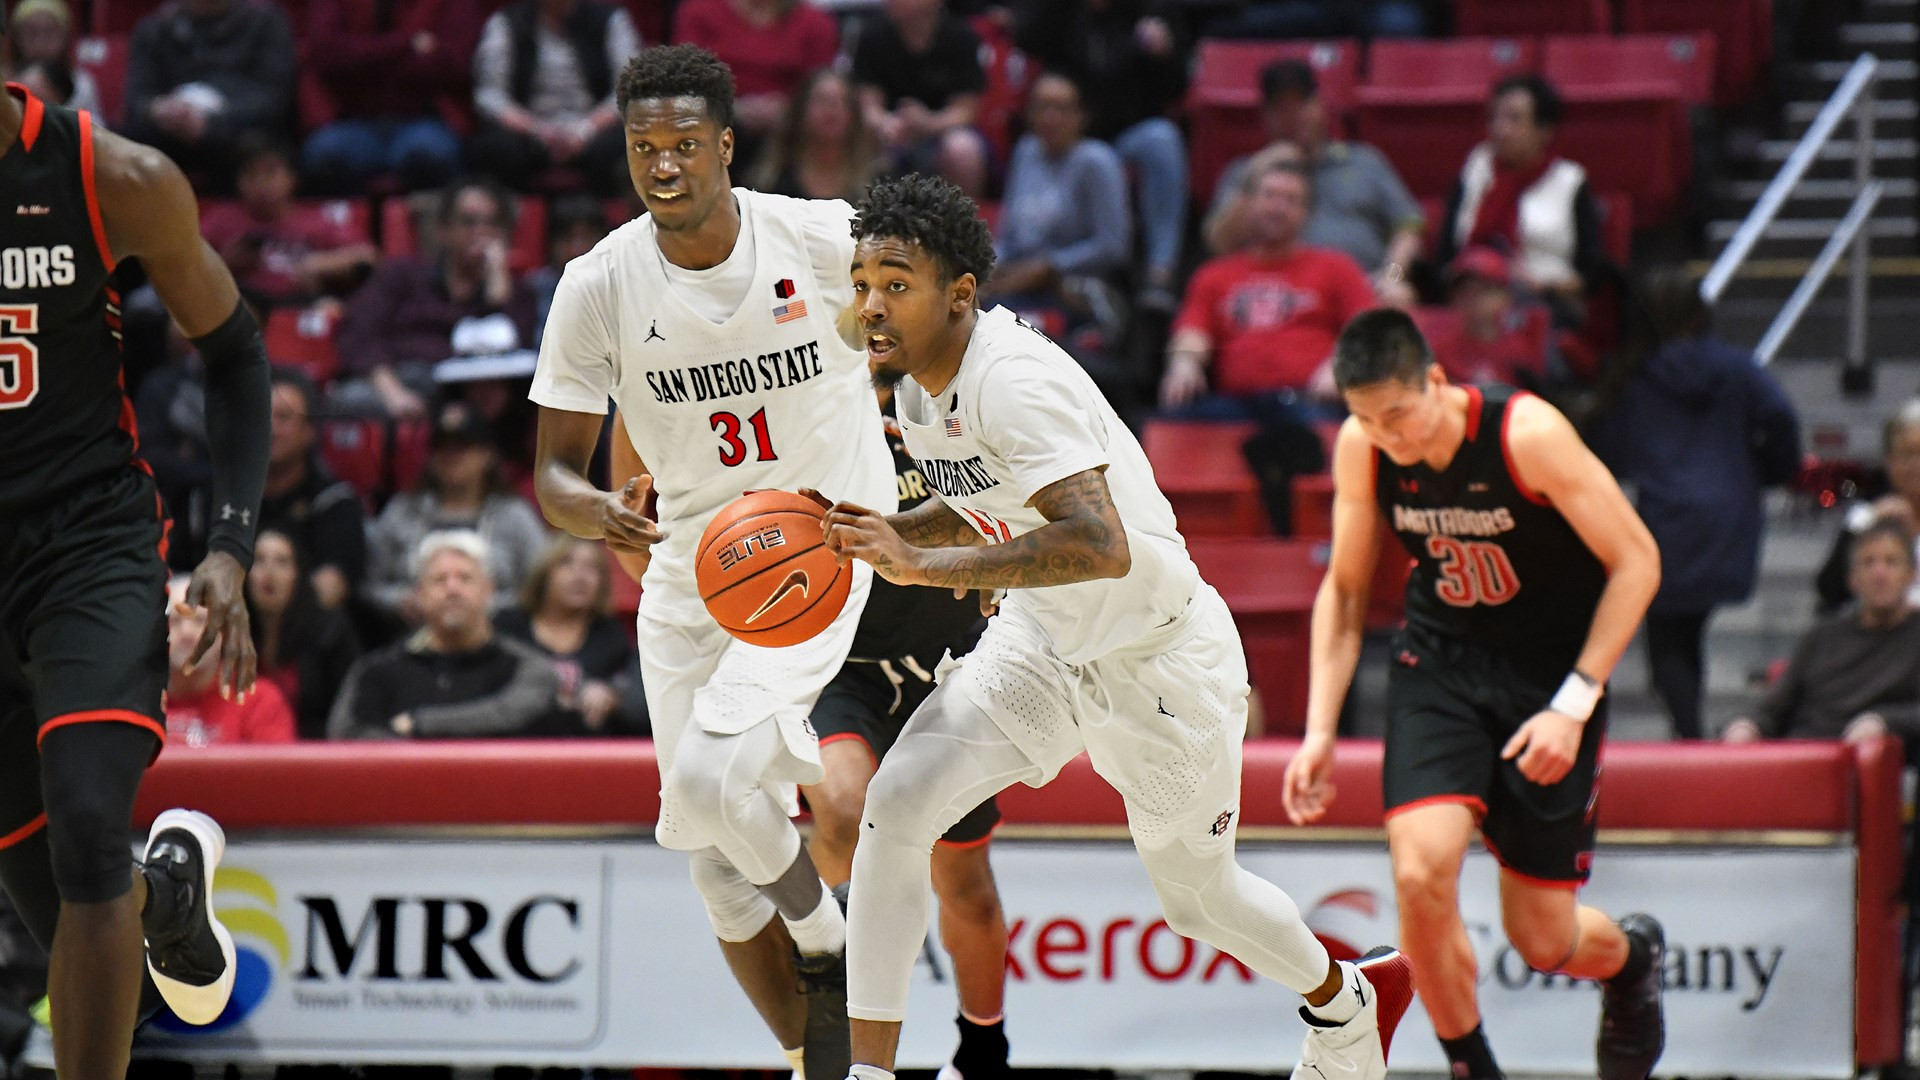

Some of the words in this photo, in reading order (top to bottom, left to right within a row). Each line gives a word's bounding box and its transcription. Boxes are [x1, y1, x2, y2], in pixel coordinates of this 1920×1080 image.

[0, 244, 76, 290] ORS
[645, 370, 690, 404] SAN
[688, 358, 757, 402] DIEGO
[757, 340, 822, 391] STATE
[709, 405, 779, 467] 31
[718, 528, 786, 572] ELITE
[1393, 503, 1515, 537] MATADORS
[1425, 534, 1521, 608] 30
[295, 895, 581, 984] MRC
[1466, 920, 1785, 1013] oany
